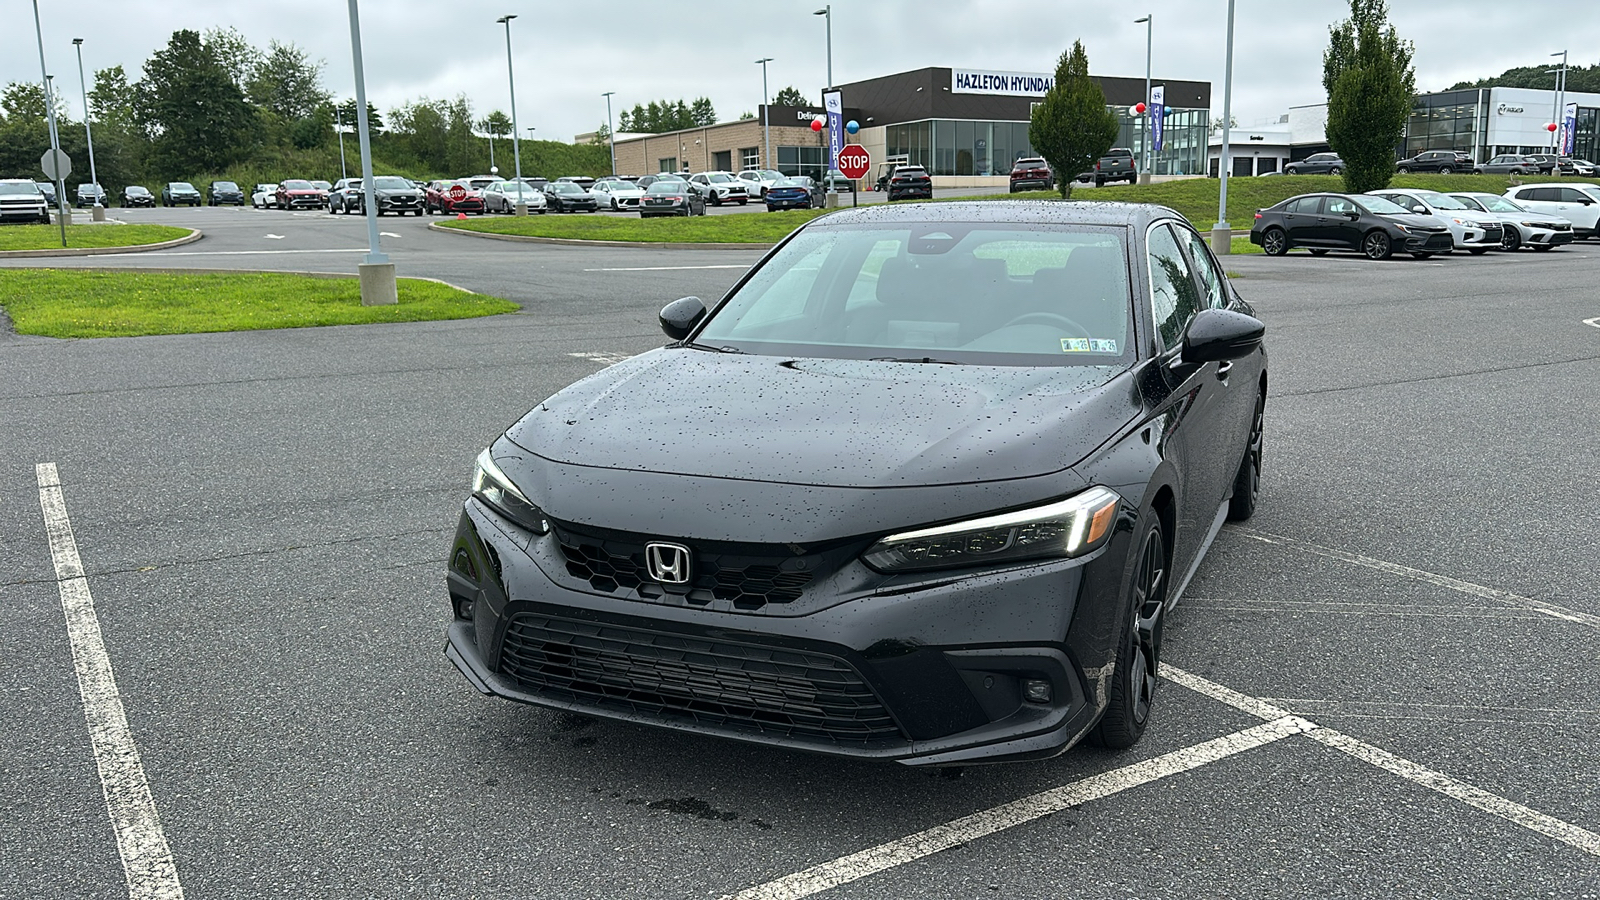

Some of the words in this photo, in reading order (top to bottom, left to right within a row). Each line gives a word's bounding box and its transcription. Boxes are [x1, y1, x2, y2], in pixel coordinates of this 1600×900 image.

[956, 73, 1008, 91] HAZLETON
[1011, 76, 1054, 92] HYUNDAI
[840, 155, 868, 169] STOP
[450, 189, 466, 197] STOP
